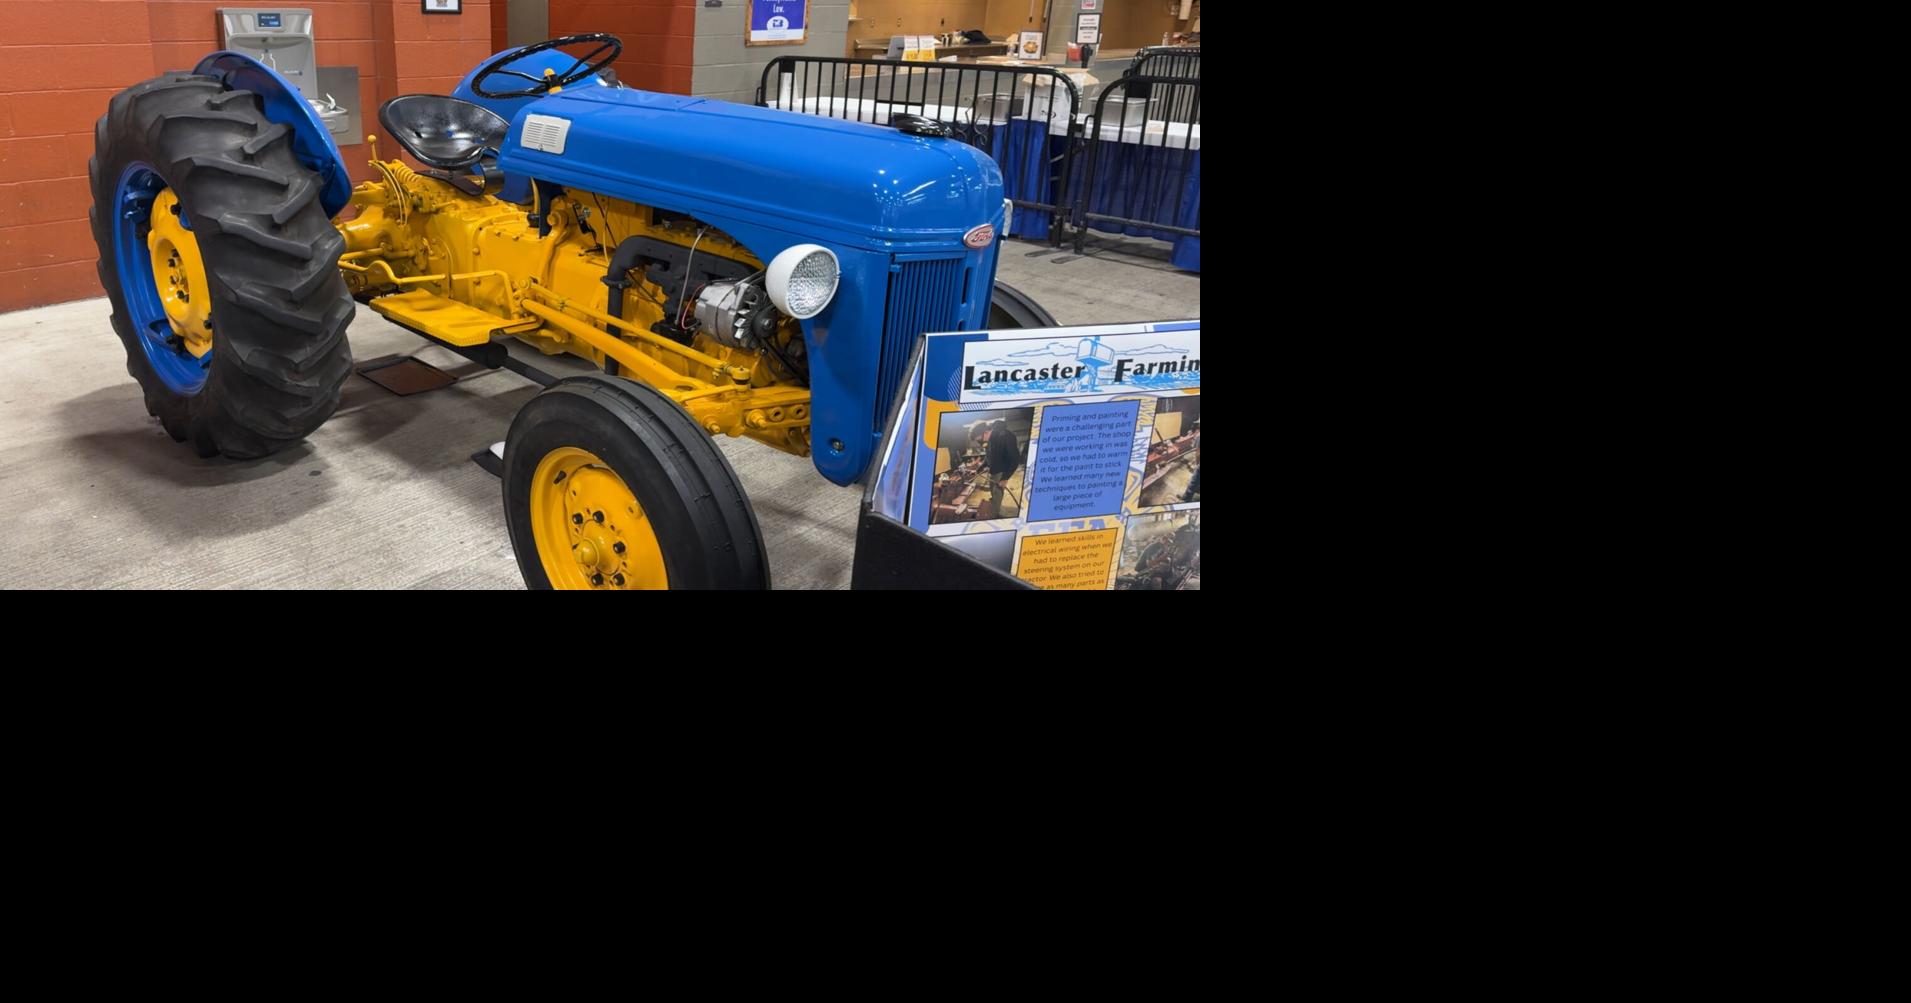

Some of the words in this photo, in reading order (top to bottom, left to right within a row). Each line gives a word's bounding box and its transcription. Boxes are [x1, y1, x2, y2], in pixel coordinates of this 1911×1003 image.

[964, 363, 1085, 390] Lancaster
[1098, 411, 1128, 419] painting
[1072, 423, 1114, 431] challenging
[1115, 421, 1131, 429] part
[1113, 431, 1132, 439] shop
[1075, 443, 1104, 451] working
[1083, 452, 1097, 460] had
[1074, 463, 1094, 471] paint
[1054, 473, 1083, 482] learned
[1034, 485, 1076, 493] techniques
[1087, 481, 1117, 489] painting
[1073, 492, 1093, 501] piece
[1048, 536, 1077, 545] learned
[1022, 547, 1057, 556] electrical
[1058, 545, 1081, 553] wiring
[1059, 554, 1086, 562] replace
[1024, 566, 1054, 574] steering
[1055, 563, 1081, 572] system
